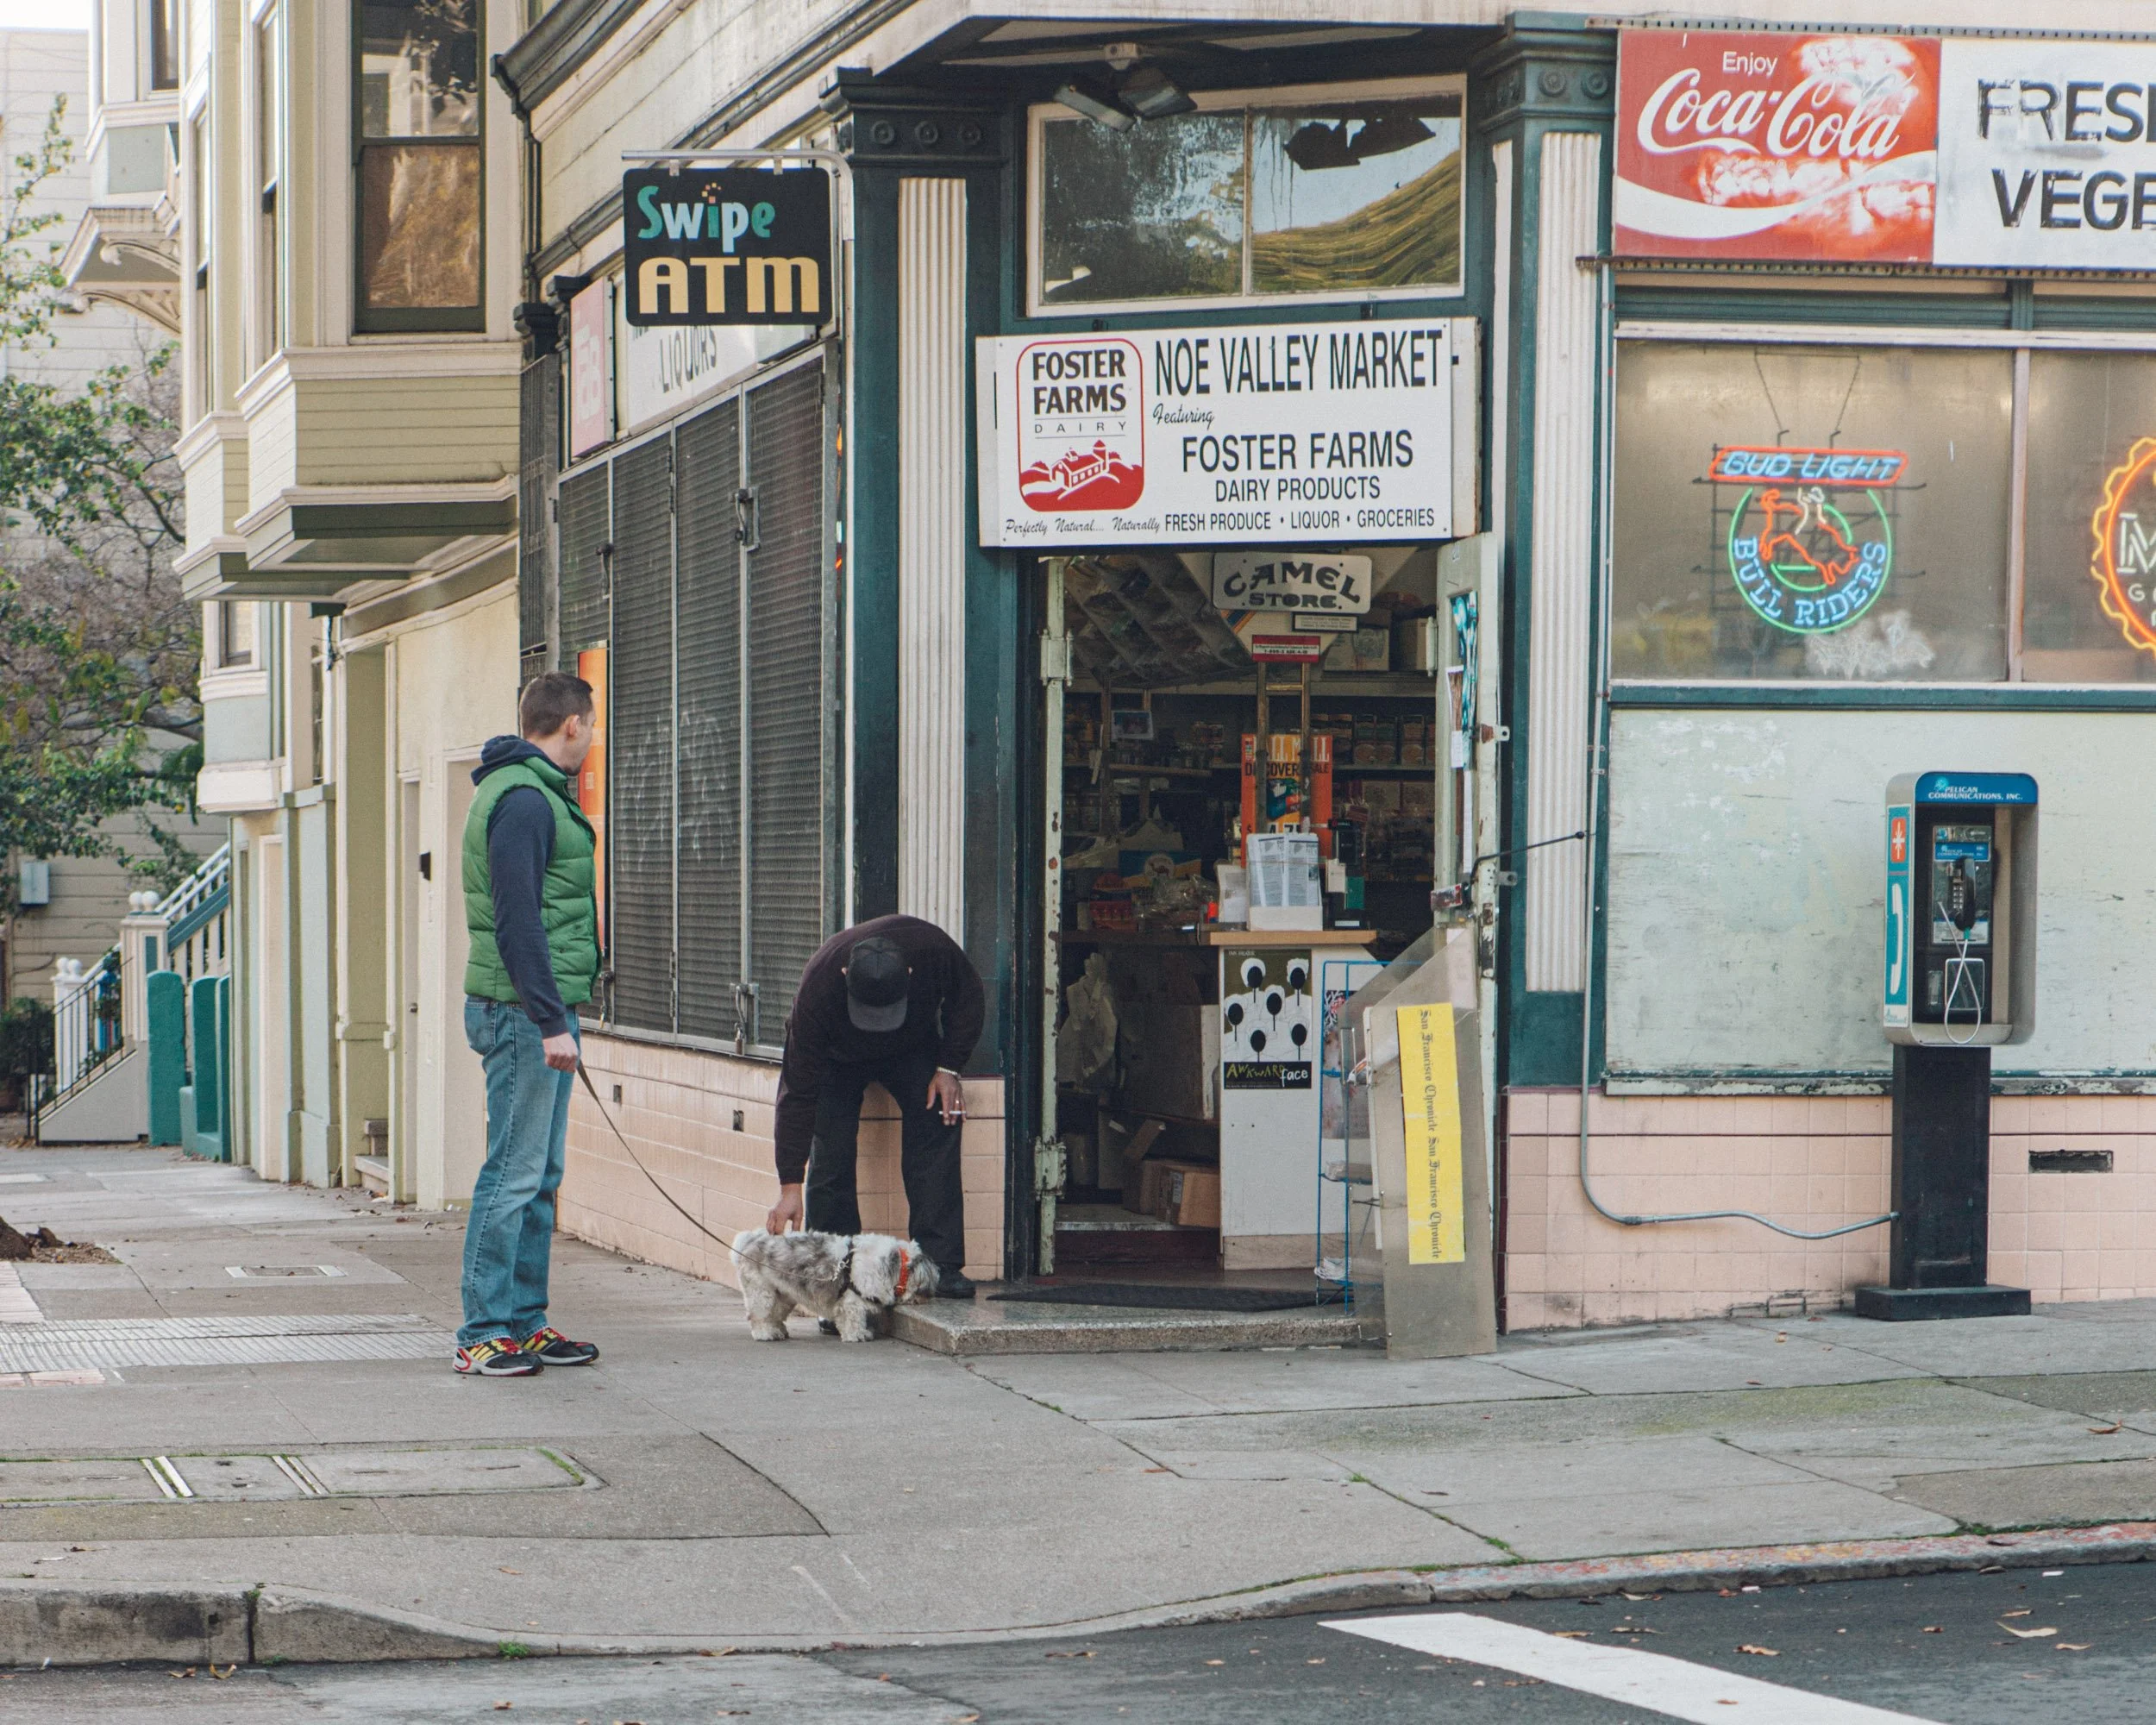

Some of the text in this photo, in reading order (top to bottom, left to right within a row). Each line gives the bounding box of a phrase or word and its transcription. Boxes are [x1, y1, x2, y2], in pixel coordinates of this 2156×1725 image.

[1722, 51, 1777, 77] Enjoy
[1637, 68, 1908, 158] Coca-Cola
[1977, 78, 2156, 142] FRES
[637, 184, 775, 253] Swipe
[638, 256, 820, 314] ATM
[660, 325, 717, 393] LIQUORS
[1032, 348, 1126, 380] FOSTER
[1156, 329, 1443, 396] NOE VALLEY MARKET
[1033, 383, 1126, 415] FARMS
[1035, 421, 1126, 433] DAIRY
[1153, 403, 1214, 430] Featuring
[1182, 430, 1414, 473] FOSTER FARMS
[1724, 450, 1901, 480] BUD LIGHT
[1215, 476, 1381, 503] DAIRY PRODUCTS
[1006, 519, 1048, 537] Perfectly
[1112, 517, 1160, 534] Naturally
[1165, 508, 1435, 532] FRESH PRODUCE LIQUOR GROCERIES
[1223, 561, 1361, 604] CAMEL
[1733, 536, 1887, 626] BULL RIDERS
[1249, 592, 1338, 609] STORE
[1280, 1069, 1308, 1087] face
[1420, 1009, 1442, 1258] San Francisco Chronicle San Francisco Chronicle
